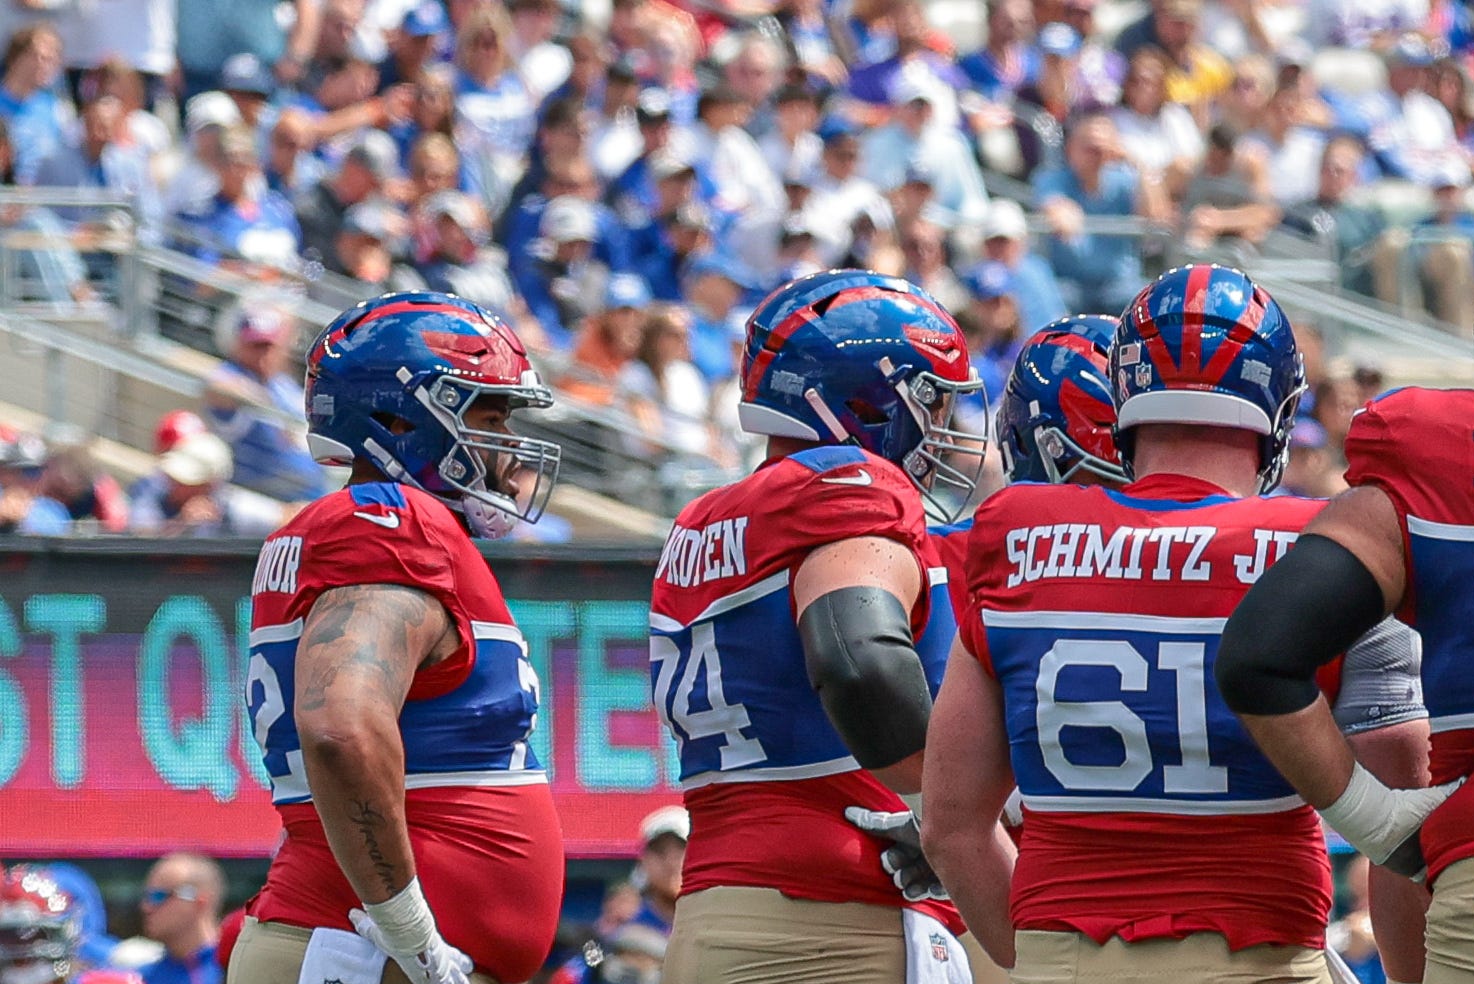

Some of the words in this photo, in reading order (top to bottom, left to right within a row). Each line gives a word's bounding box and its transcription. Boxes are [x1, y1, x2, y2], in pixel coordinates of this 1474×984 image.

[1006, 524, 1216, 589] SCHMITZ
[650, 621, 768, 771] 74
[1036, 639, 1228, 793] 61
